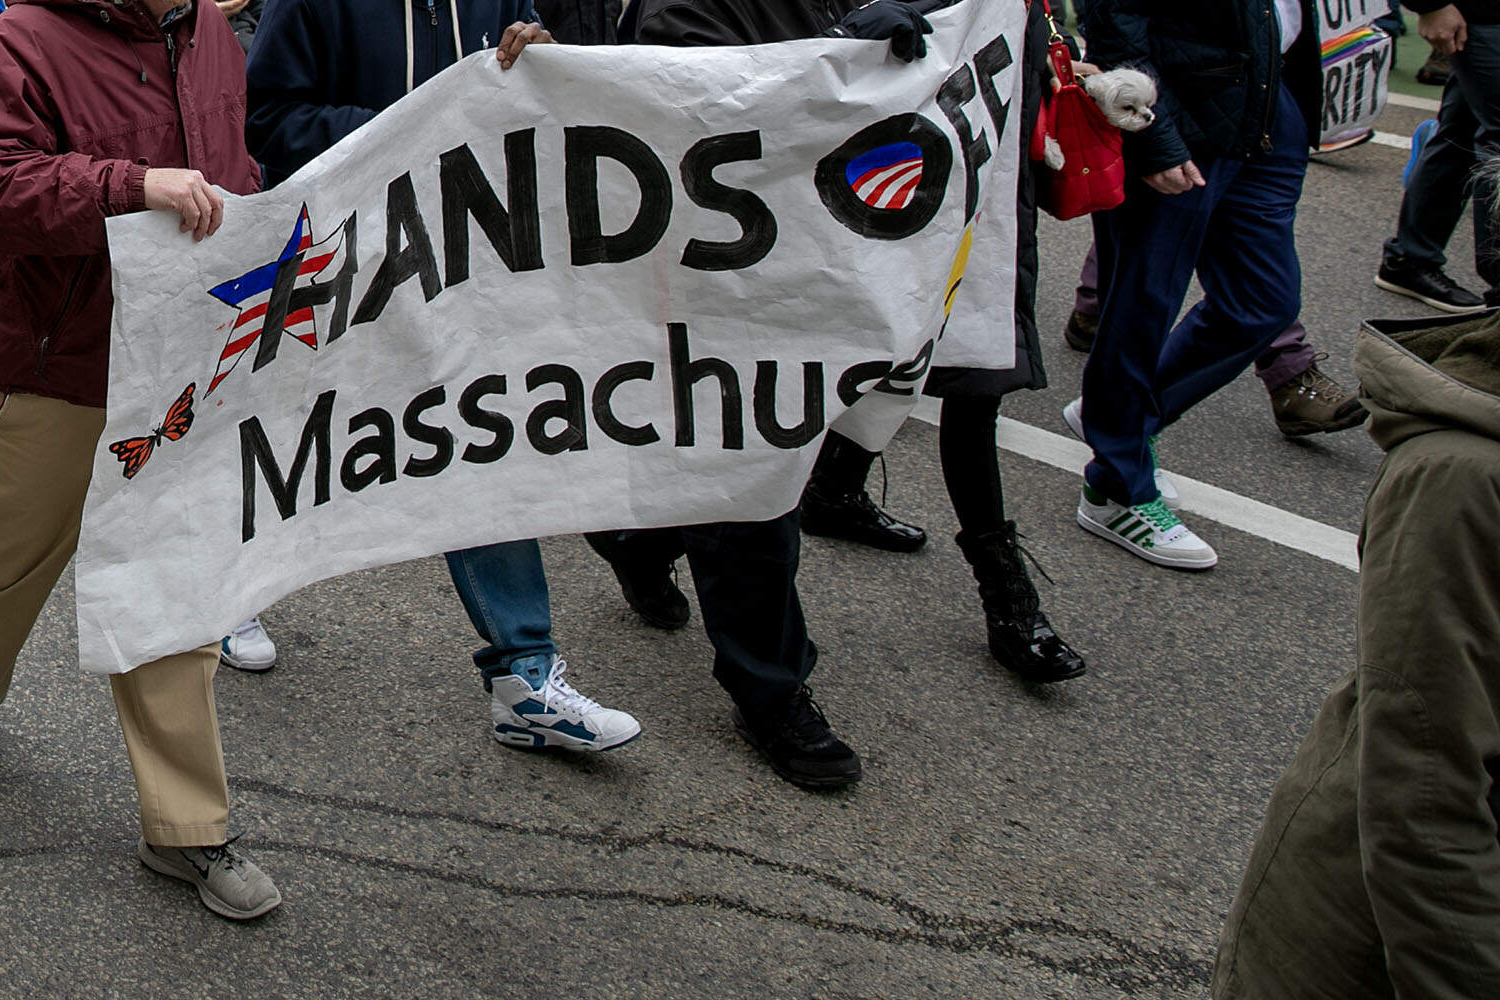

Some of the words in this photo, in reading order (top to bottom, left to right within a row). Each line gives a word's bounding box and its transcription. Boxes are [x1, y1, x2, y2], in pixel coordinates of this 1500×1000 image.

[1322, 43, 1391, 132] RITY
[252, 126, 780, 374] HANDS
[814, 34, 1016, 240] OFF
